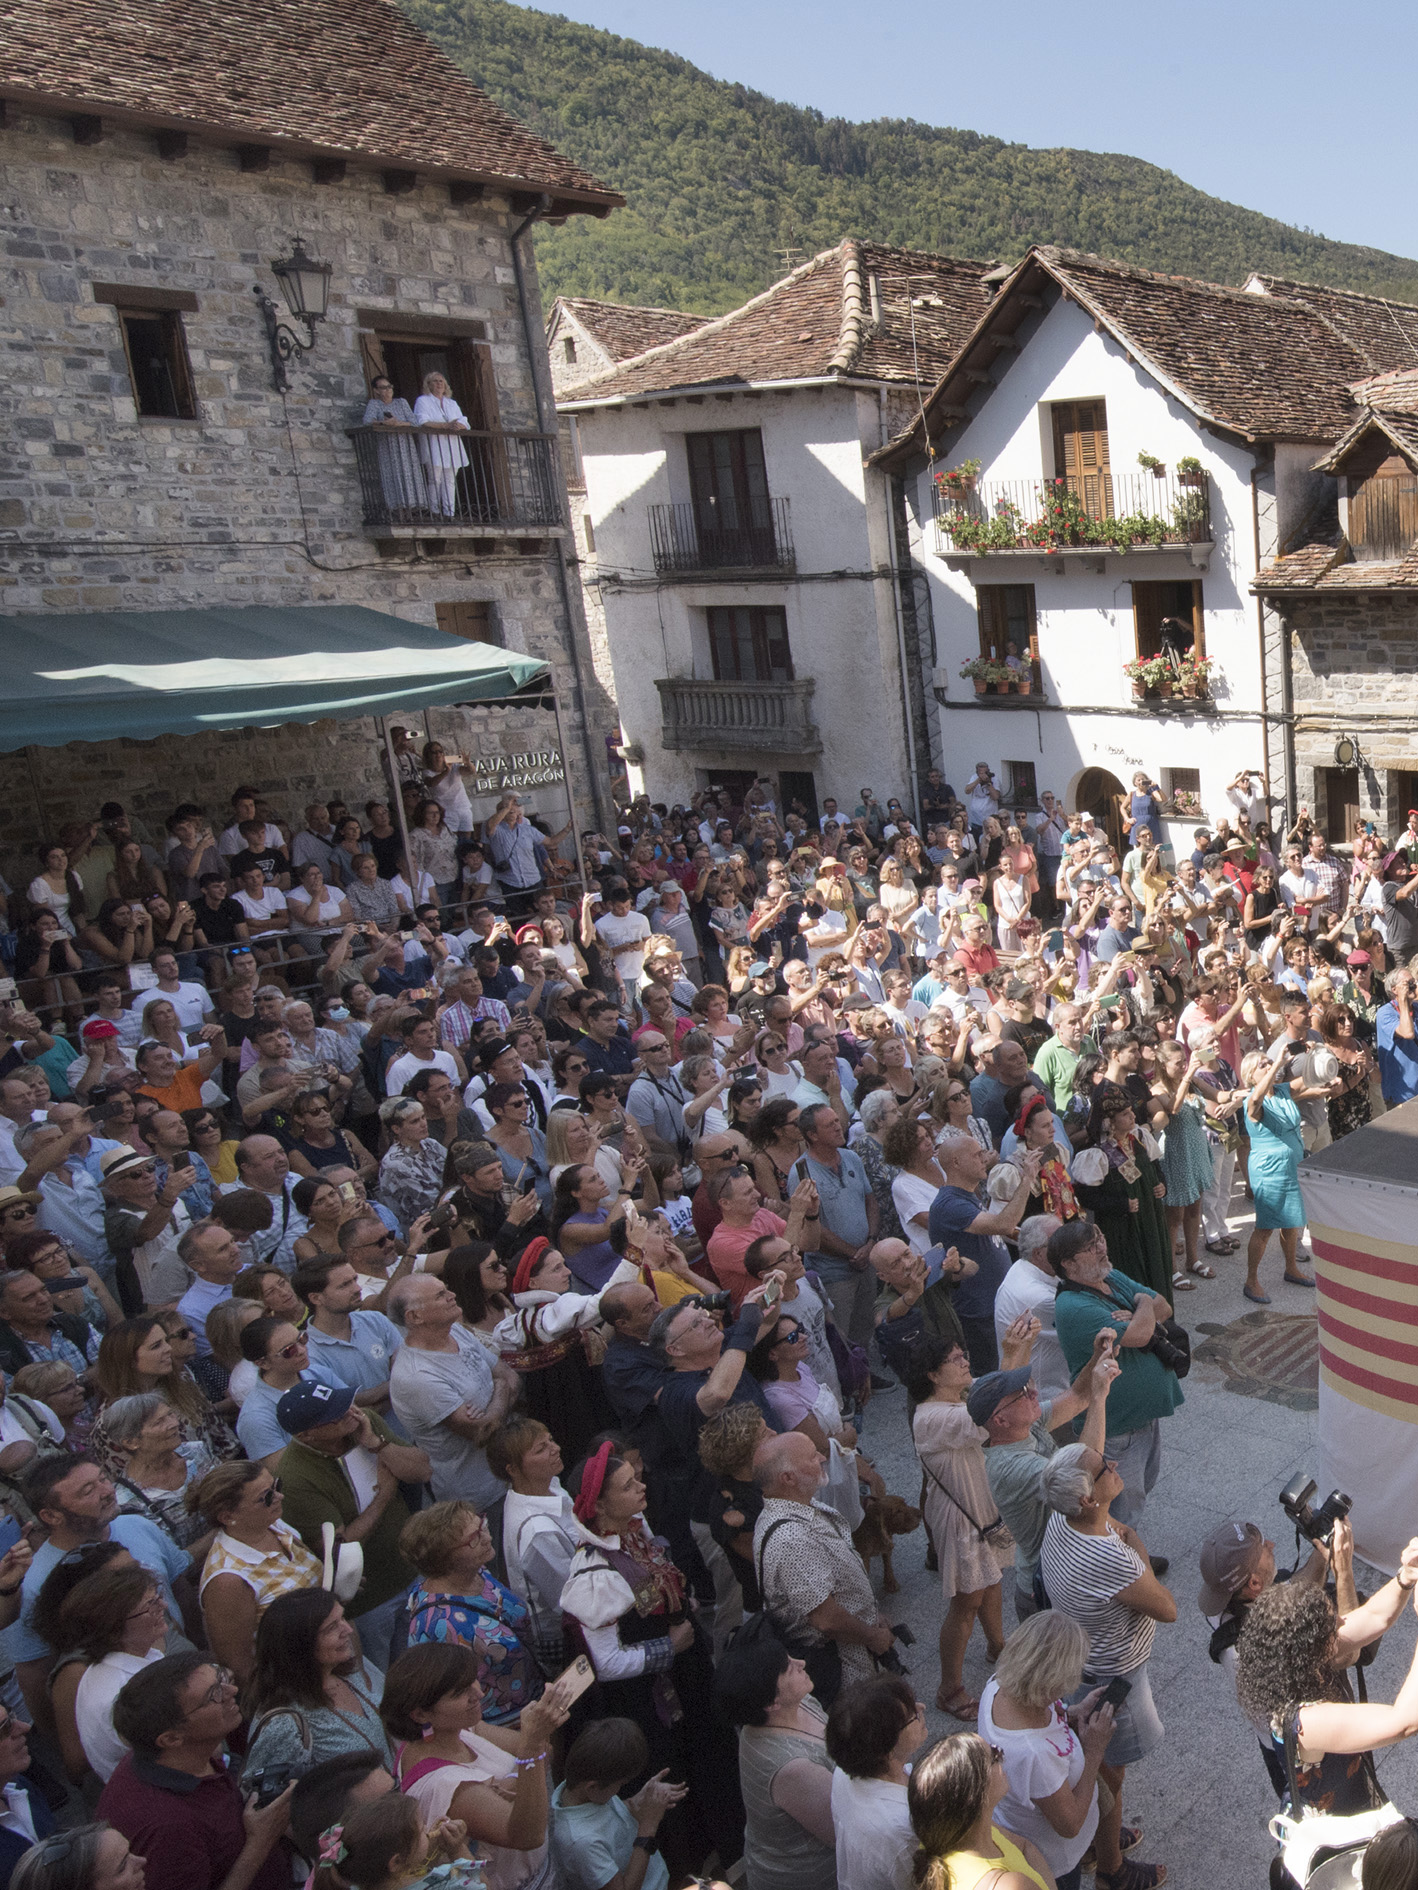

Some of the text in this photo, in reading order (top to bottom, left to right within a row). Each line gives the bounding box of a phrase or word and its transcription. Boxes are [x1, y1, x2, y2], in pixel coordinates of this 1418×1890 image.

[475, 751, 563, 773] AJA RURA
[476, 768, 565, 792] DE ARAGÓN
